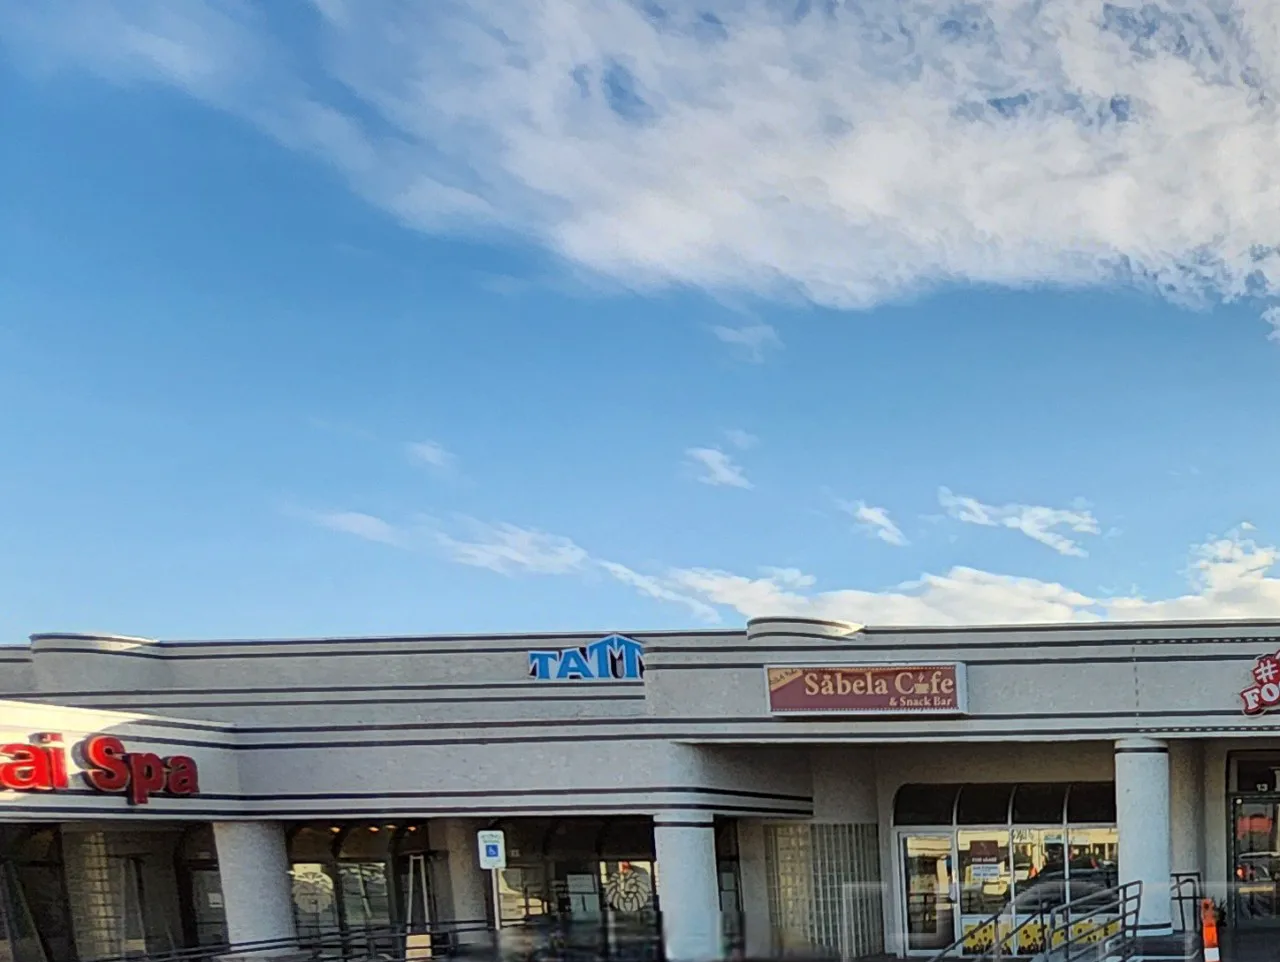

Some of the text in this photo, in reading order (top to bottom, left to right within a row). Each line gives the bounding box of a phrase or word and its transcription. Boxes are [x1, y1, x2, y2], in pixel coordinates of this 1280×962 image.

[527, 633, 645, 681] TATT
[888, 695, 953, 707] & Snack Bar
[894, 671, 954, 695] Cfe
[80, 734, 200, 806] Spa
